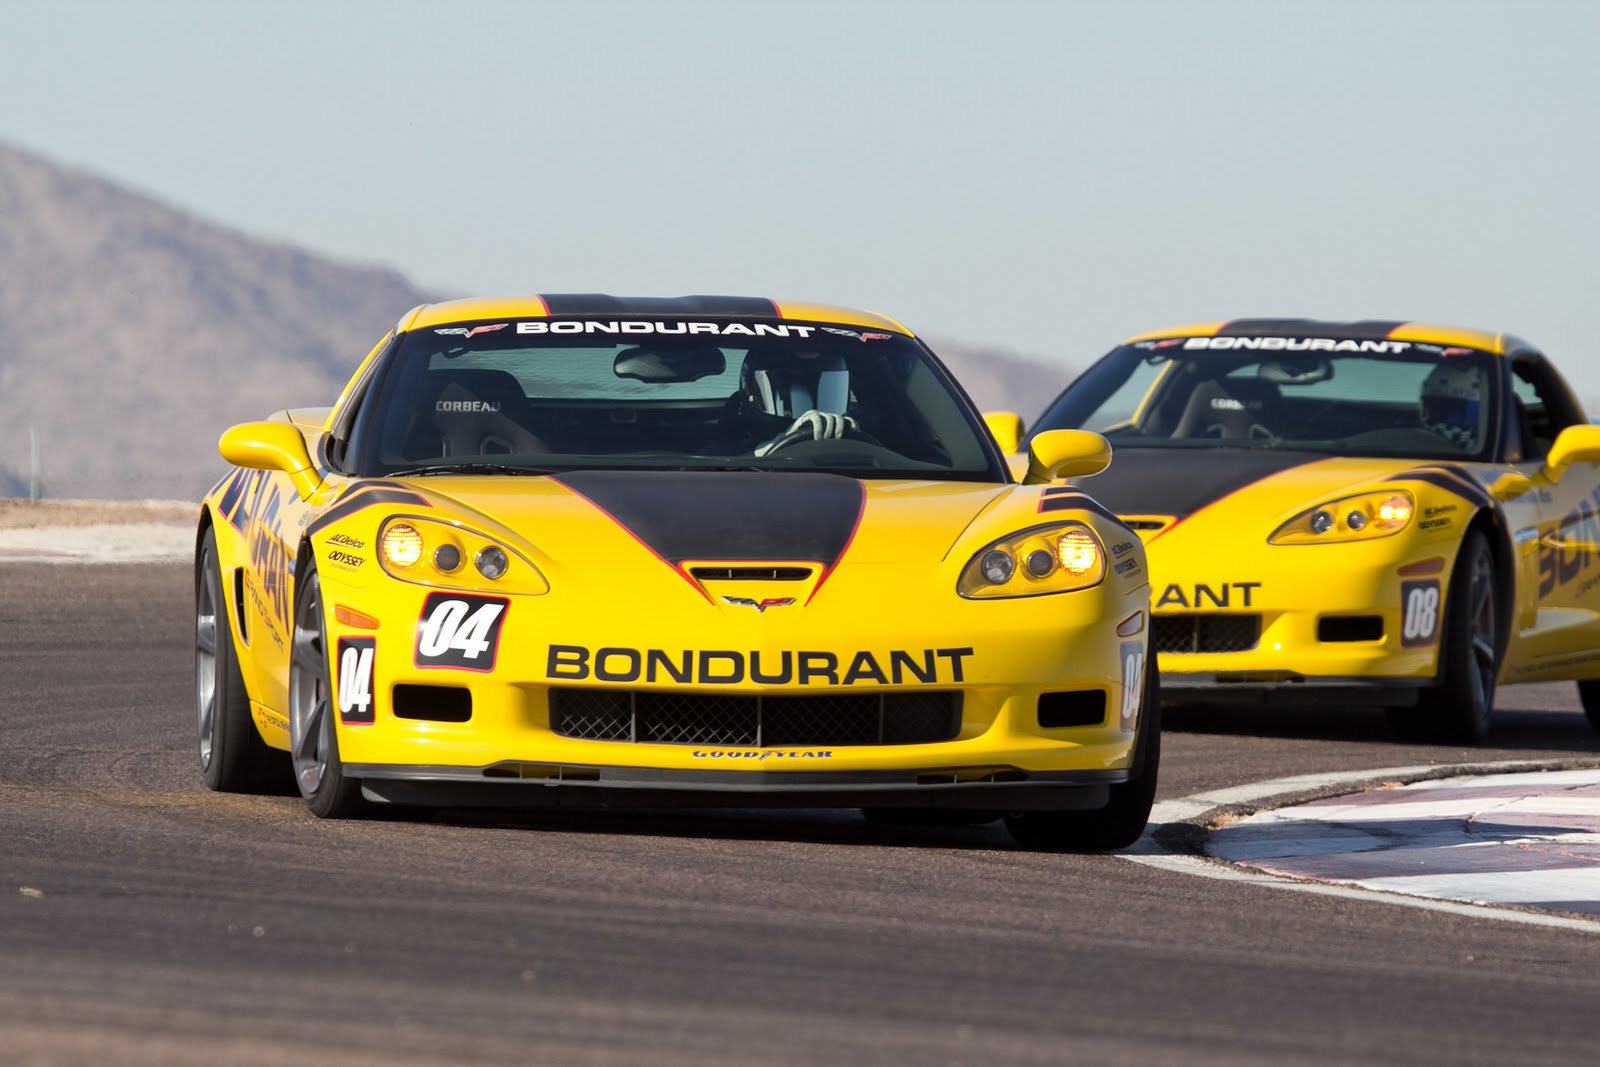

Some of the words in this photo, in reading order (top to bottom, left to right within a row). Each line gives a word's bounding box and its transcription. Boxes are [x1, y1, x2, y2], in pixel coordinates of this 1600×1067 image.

[516, 321, 815, 338] BONDURANT
[1183, 336, 1411, 353] BONDURANT
[328, 550, 366, 567] ODYSSEY
[1404, 587, 1439, 640] 08
[418, 600, 504, 659] 04
[546, 644, 974, 685] BONDURANT
[339, 647, 374, 713] 04
[692, 750, 832, 762] GOODYEAR
